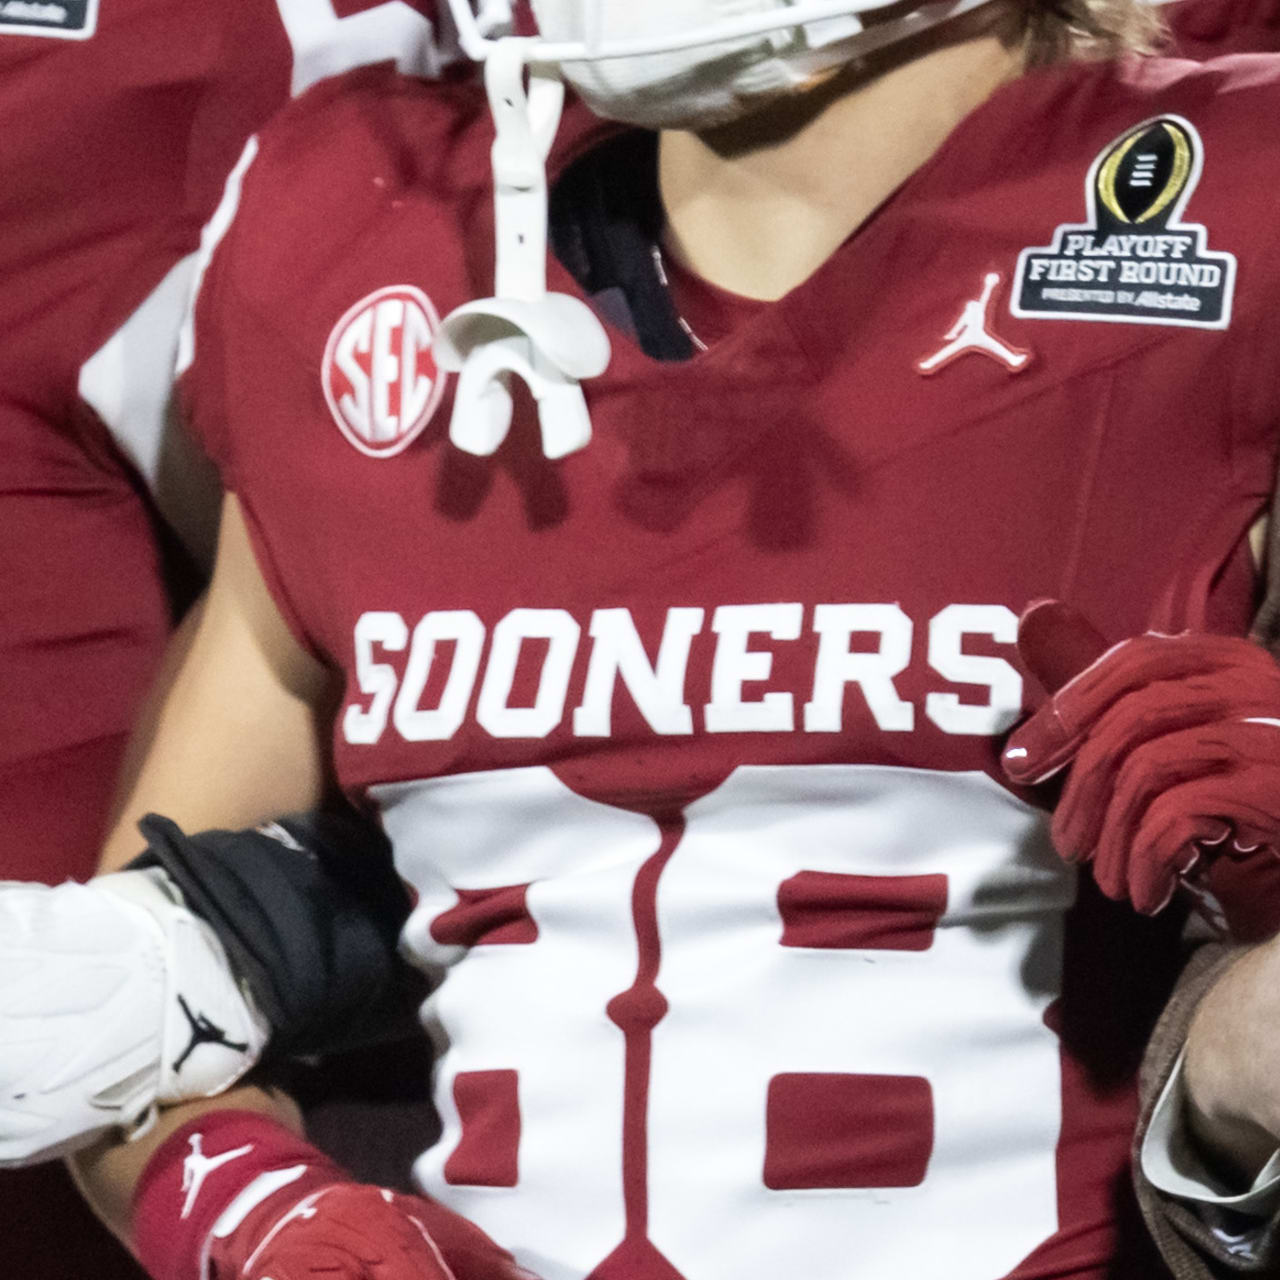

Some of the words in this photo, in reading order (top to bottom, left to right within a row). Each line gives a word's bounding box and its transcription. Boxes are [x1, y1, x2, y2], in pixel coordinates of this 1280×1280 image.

[1029, 259, 1116, 282] FIRST
[1119, 261, 1221, 288] ROUND
[1064, 234, 1192, 258] PLAYOFF
[336, 299, 432, 441] SEC
[344, 603, 1023, 744] SOONERS
